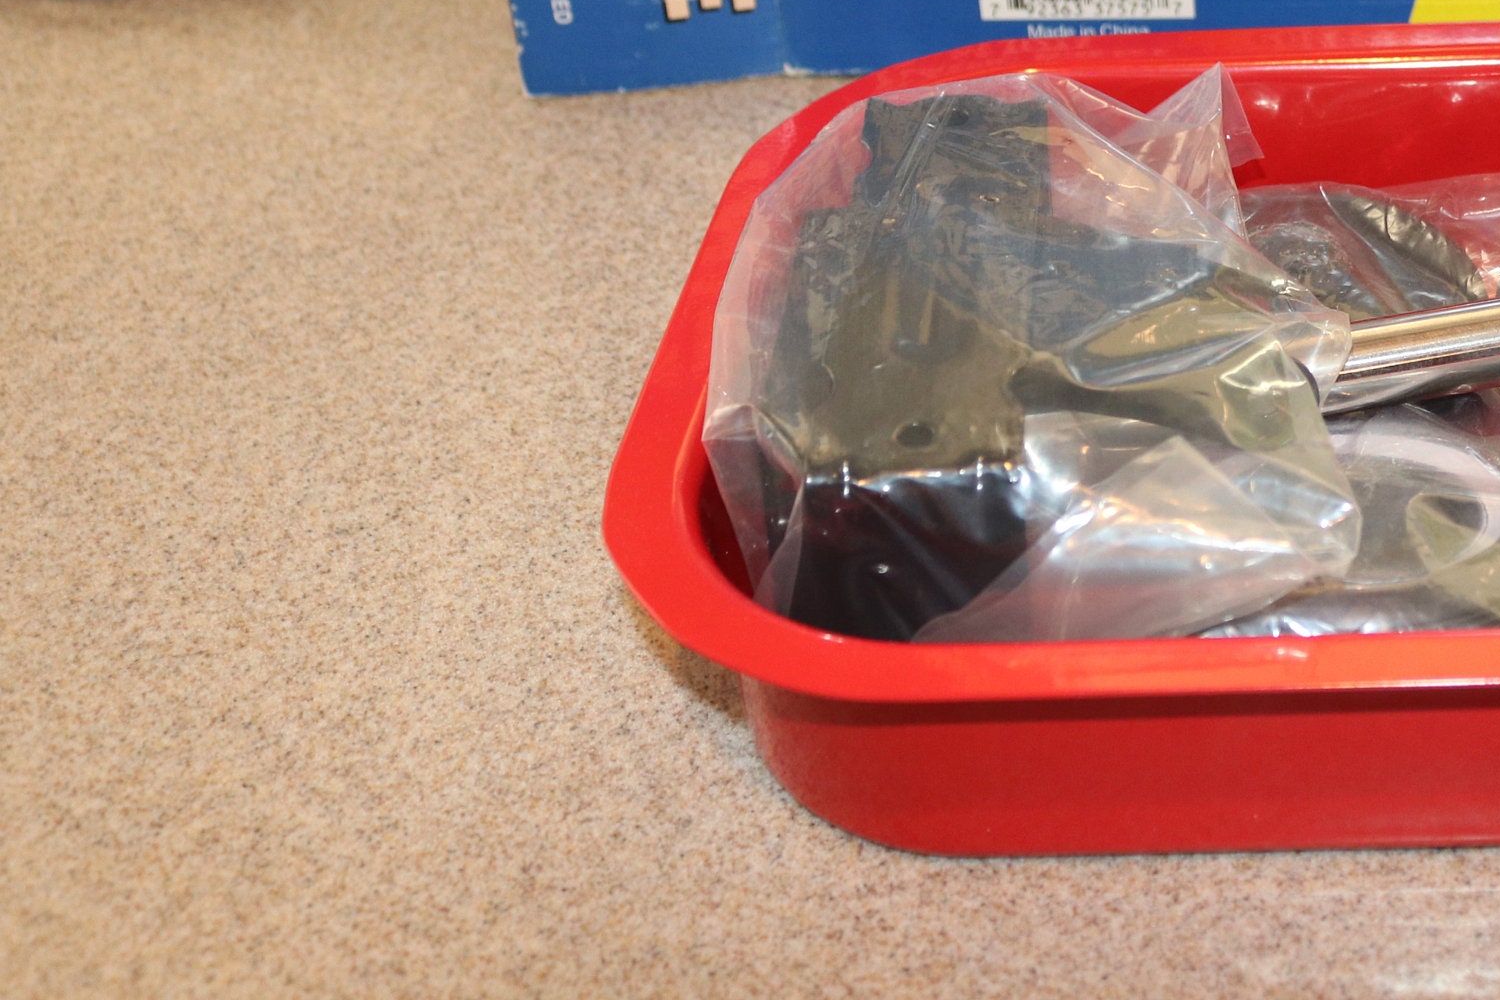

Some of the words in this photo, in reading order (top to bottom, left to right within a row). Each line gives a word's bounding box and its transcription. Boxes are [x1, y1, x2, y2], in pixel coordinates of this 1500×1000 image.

[1027, 23, 1075, 38] Made
[1079, 23, 1094, 36] in
[1100, 22, 1151, 35] China
